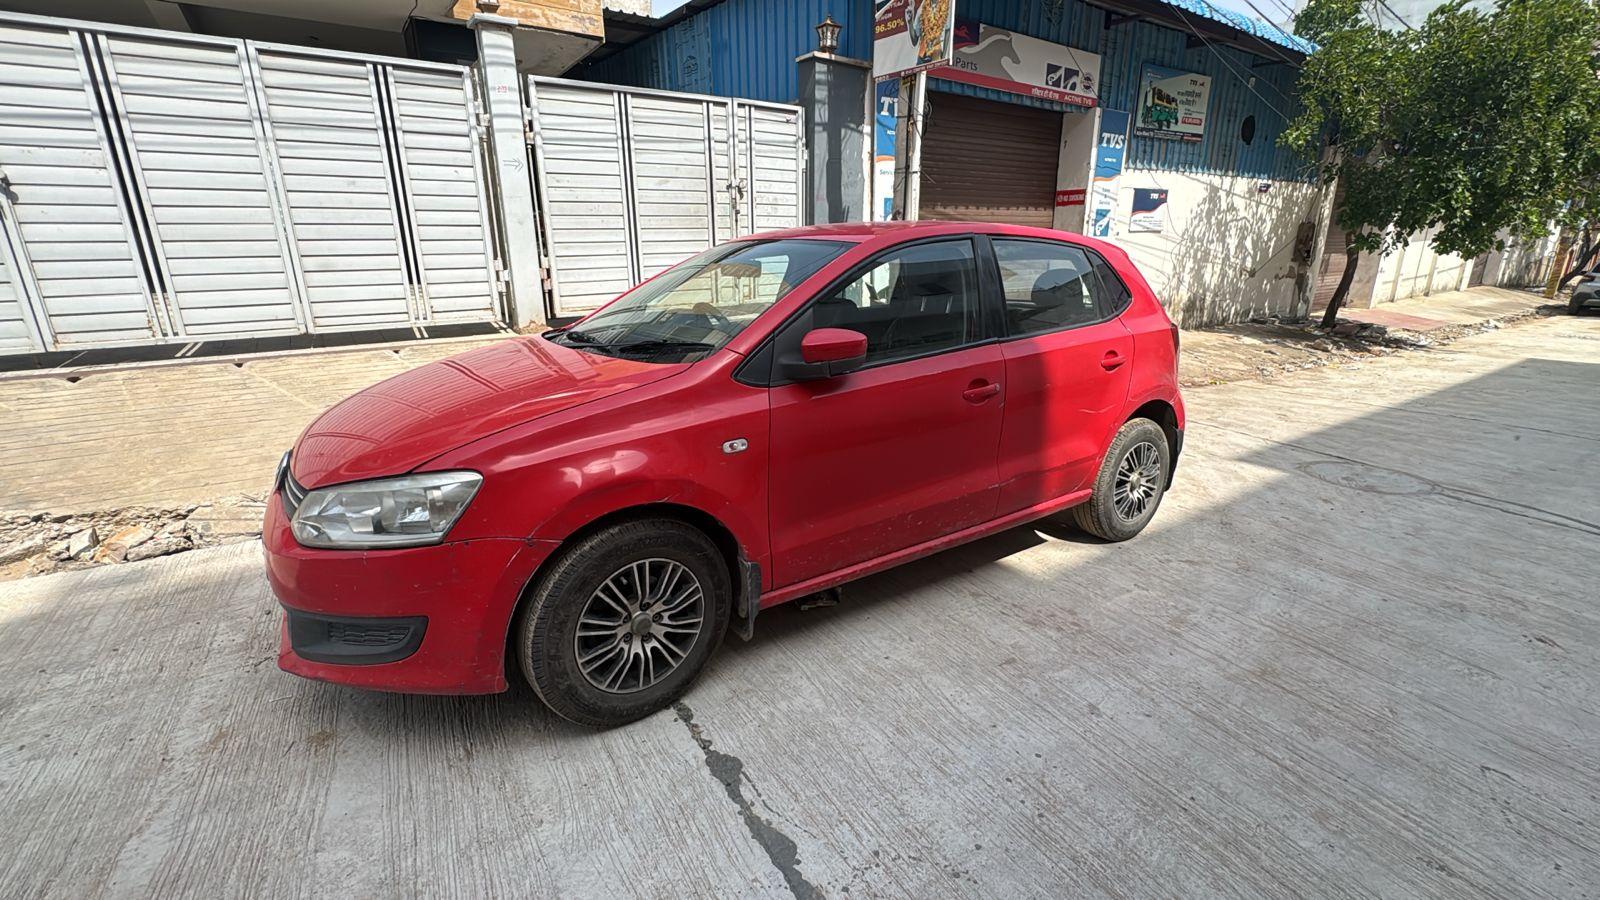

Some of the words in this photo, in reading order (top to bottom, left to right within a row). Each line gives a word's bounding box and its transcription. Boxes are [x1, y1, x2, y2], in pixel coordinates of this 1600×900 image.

[875, 18, 905, 34] 96.50%
[955, 57, 978, 71] Parts
[1063, 94, 1082, 104] ACTIVE
[1082, 98, 1092, 106] TVS
[1102, 132, 1125, 149] TVS
